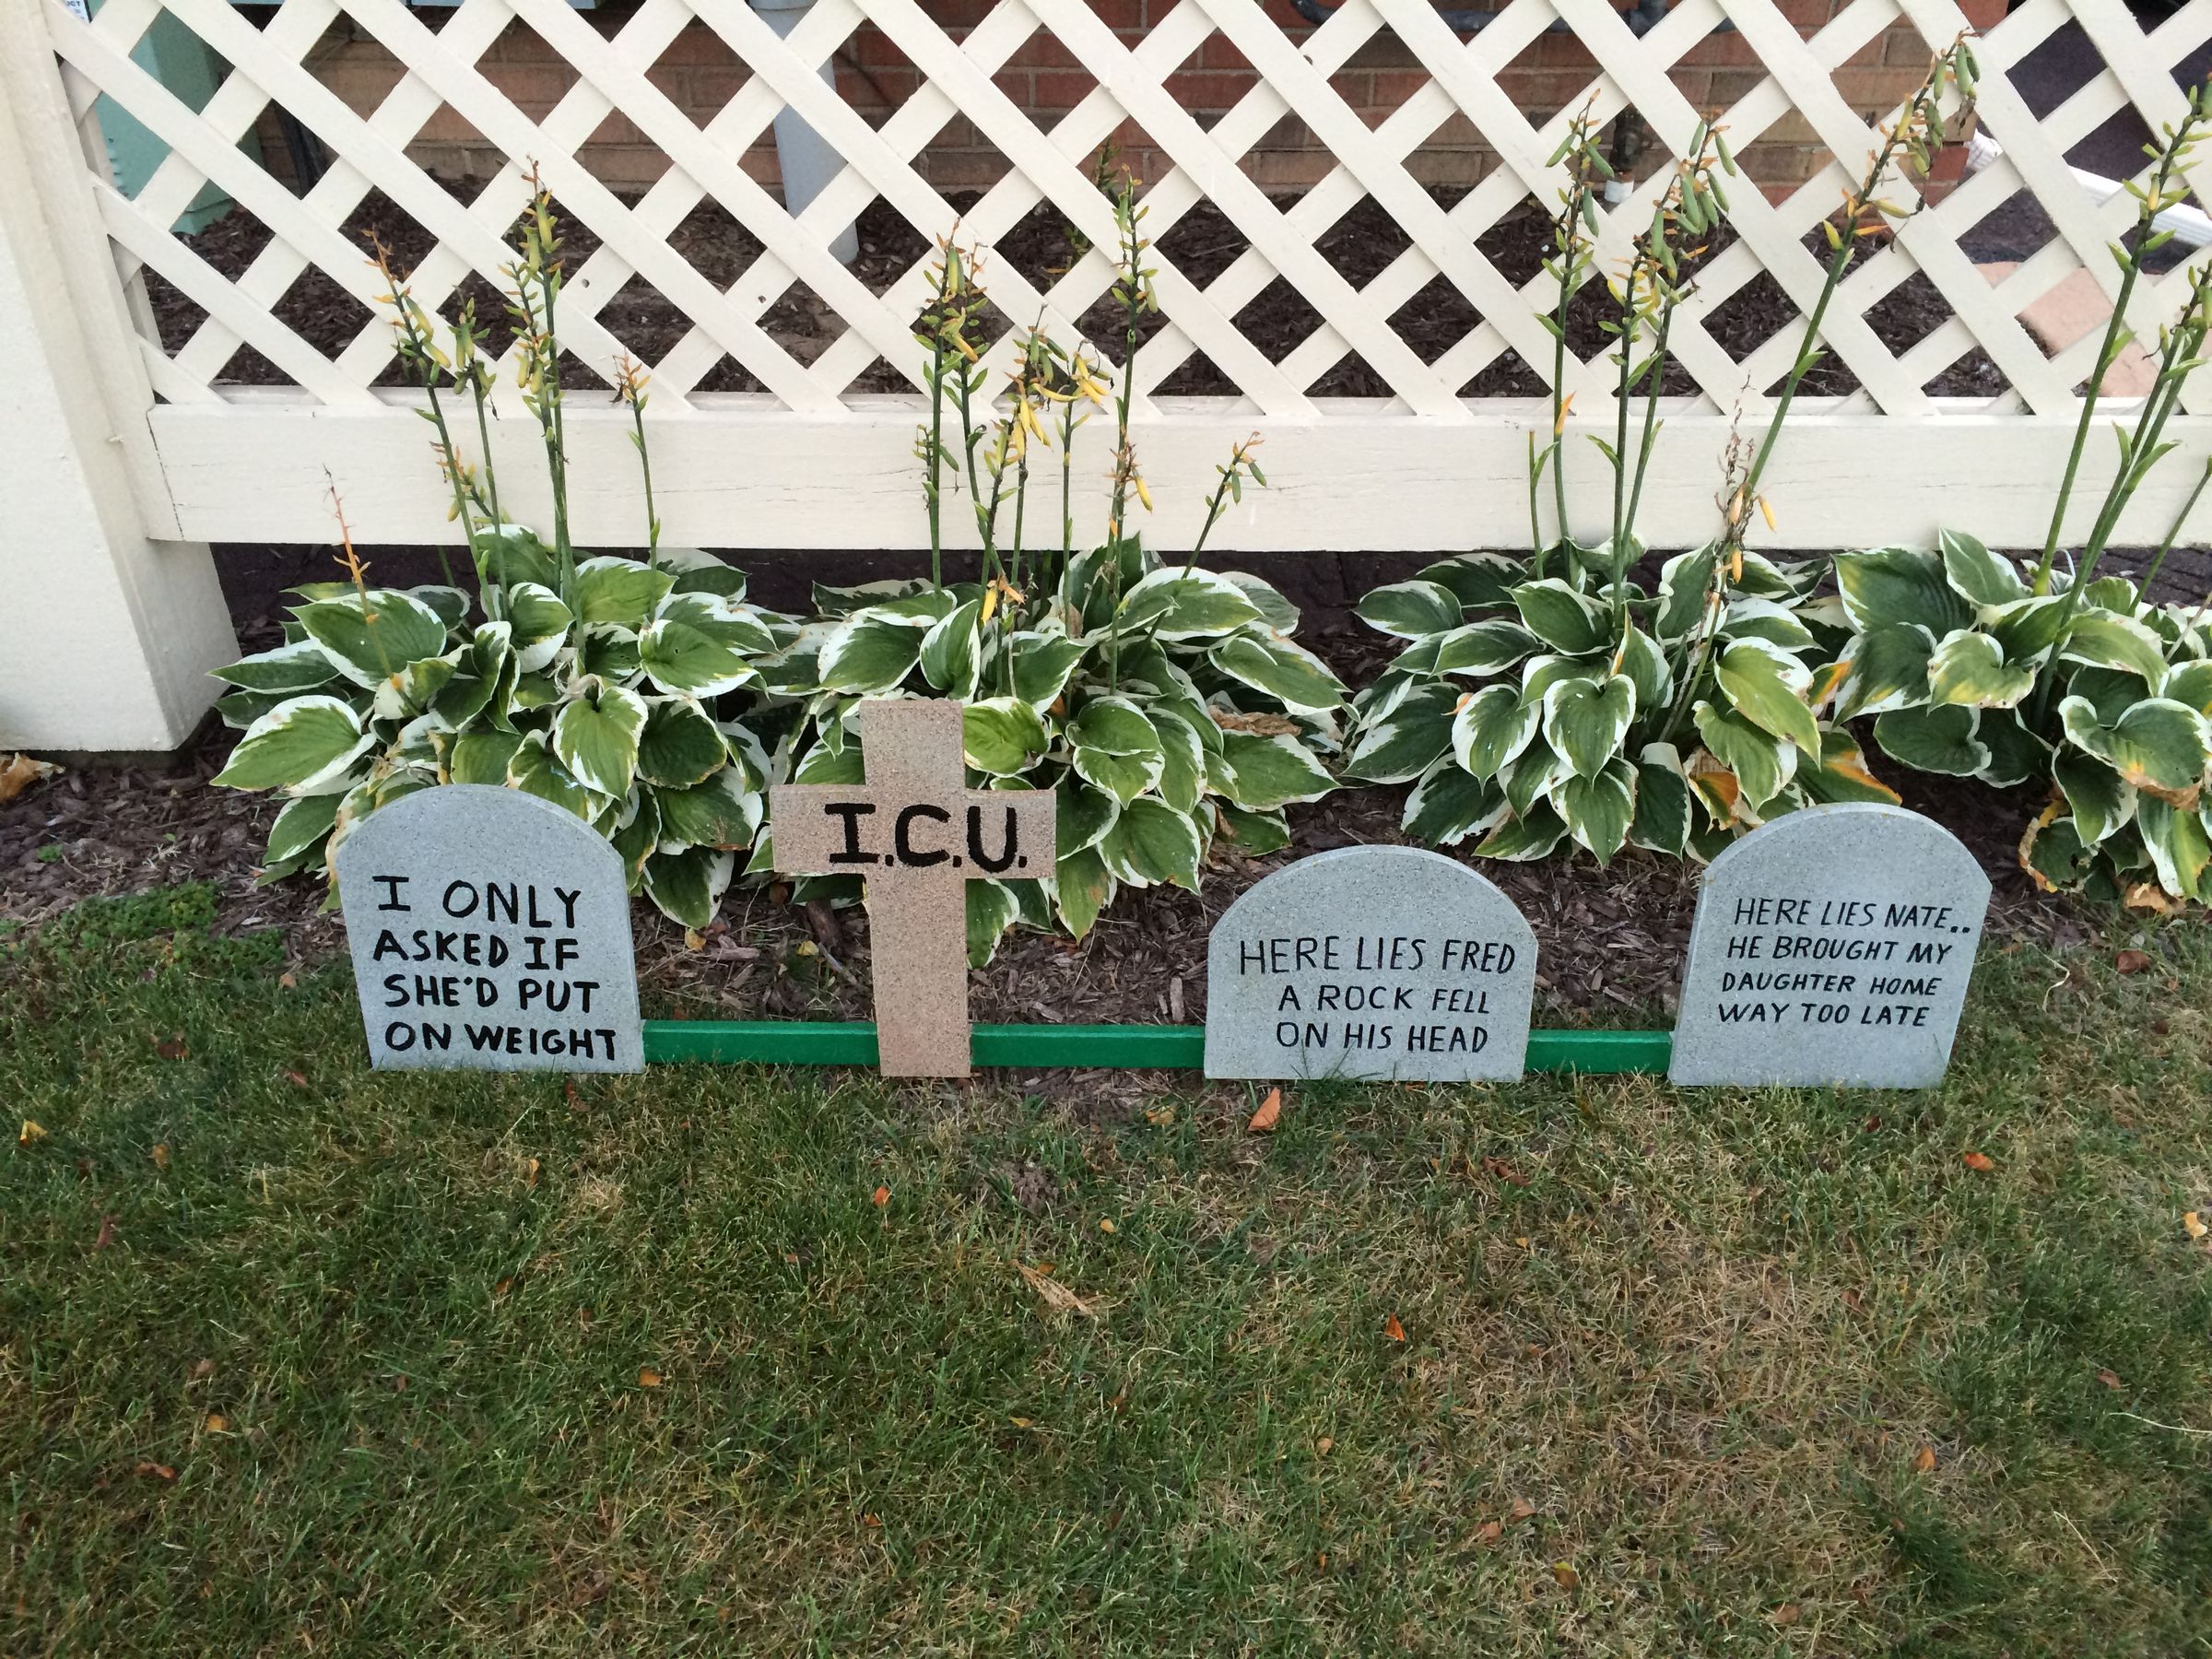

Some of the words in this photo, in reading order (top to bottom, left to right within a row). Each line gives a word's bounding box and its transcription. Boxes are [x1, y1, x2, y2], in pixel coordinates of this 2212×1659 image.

[824, 803, 1028, 873] I.C.U.
[372, 876, 411, 912] I
[442, 880, 581, 929] ONLY
[1735, 898, 1811, 925] HERE
[1821, 901, 1877, 926] LIES
[1884, 904, 1971, 934] NATE..
[372, 930, 509, 968] ASKED
[524, 936, 579, 971] IF
[1241, 935, 1339, 975] HERE
[1357, 936, 1427, 971] LIES
[1442, 939, 1515, 974] FRED
[1727, 935, 1763, 959] HE
[1772, 935, 1899, 960] BROUGHT
[1906, 943, 1952, 965] MY
[384, 974, 498, 1007] SHE'D
[519, 979, 600, 1013] PUT
[1278, 985, 1300, 1011] A
[1318, 985, 1413, 1011] ROCK
[1432, 988, 1489, 1014] FELL
[1722, 972, 1855, 993] DAUGHTER
[1869, 977, 1942, 995] HOME
[1718, 1003, 1789, 1023] WAY
[1801, 1003, 1850, 1024] TOO
[1861, 1006, 1930, 1026] LATE
[385, 1021, 451, 1051] ON
[465, 1024, 616, 1061] WEIGHT
[1277, 1022, 1328, 1048] ON
[1344, 1023, 1393, 1049] HIS
[1407, 1025, 1488, 1053] HEAD
